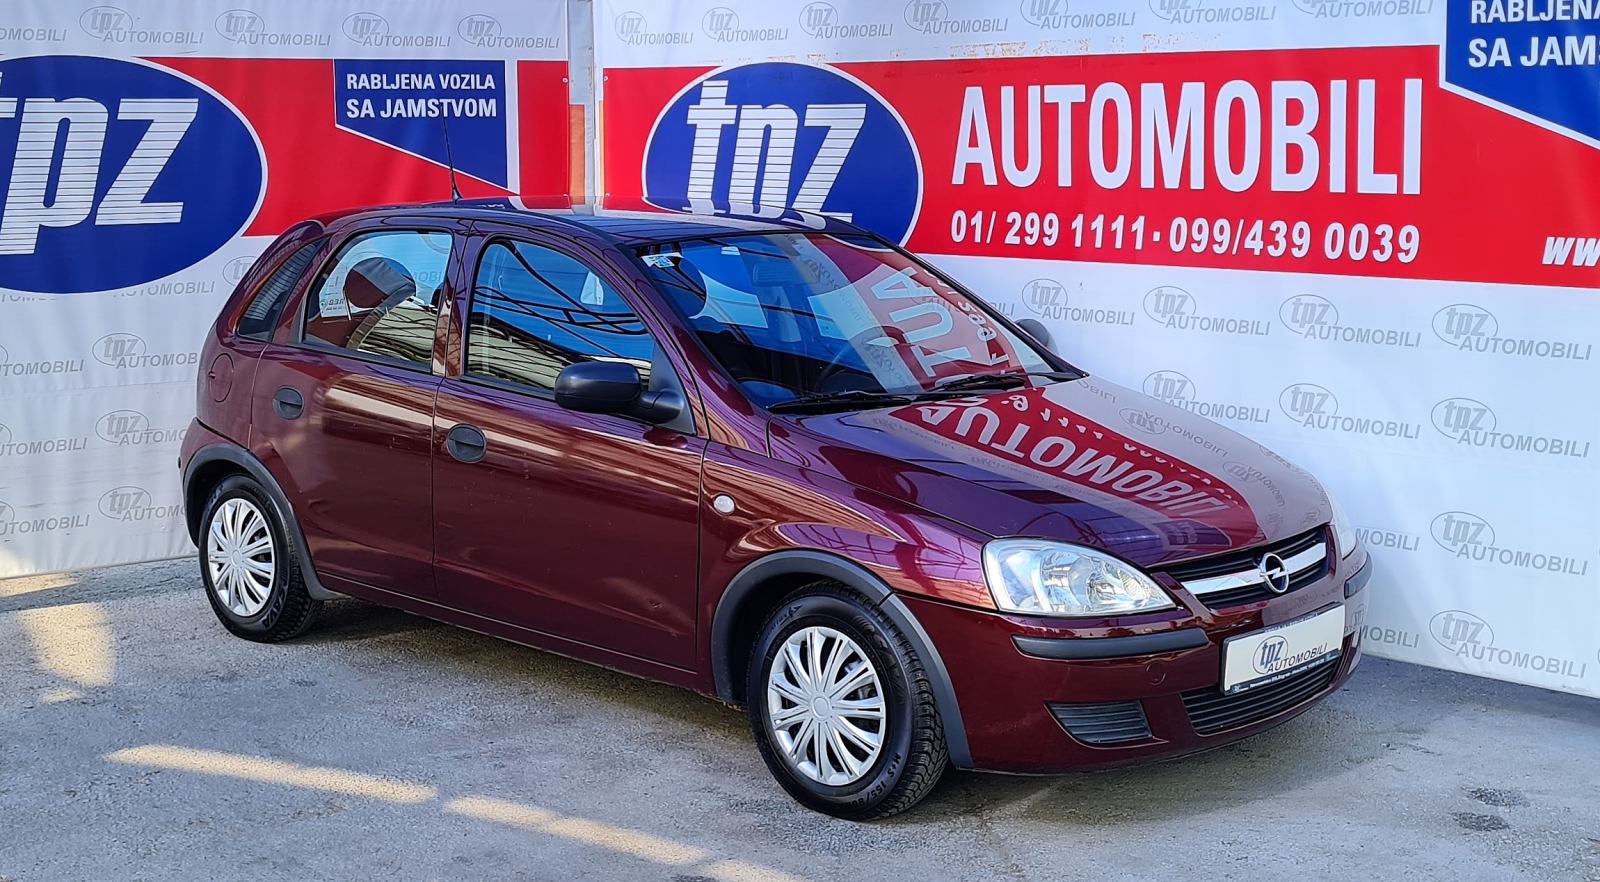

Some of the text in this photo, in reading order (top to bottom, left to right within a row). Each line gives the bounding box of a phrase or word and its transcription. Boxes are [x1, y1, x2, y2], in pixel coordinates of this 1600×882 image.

[1170, 6, 1276, 24] AUTOMOBILI
[1315, 0, 1434, 19] AUTOMOBILI
[1471, 0, 1600, 23] RABLJEN
[923, 17, 1009, 35] AUTOMOBILI
[1041, 12, 1136, 29] AUTOMOBILI
[103, 30, 204, 44] AUTOMOBILI
[237, 33, 331, 46] AUTOMOBILI
[363, 35, 451, 47] AUTOMOBILI
[627, 32, 694, 46] AUTOMOBILI
[717, 28, 789, 42] AUTOMOBILI
[815, 24, 894, 39] AUTOMOBILI
[476, 37, 560, 49] AUTOMOBILI
[1468, 35, 1600, 68] SA JAM
[347, 74, 496, 90] RABLJENA VOZILA
[346, 98, 497, 118] SA JAMSTVOM
[952, 78, 1423, 195] AUTOMOBILI
[0, 72, 199, 255] pz
[951, 210, 997, 244] 01/
[1004, 212, 1060, 246] 299
[1324, 223, 1421, 264] 0039
[1040, 305, 1135, 326] AUTOMOBILI
[1166, 315, 1271, 336] AUTOMOBILI
[1303, 324, 1422, 348] AUTOMOBILI
[1459, 335, 1593, 361] AUTOMOBILI
[116, 352, 198, 369] AUTOMOB
[1303, 413, 1422, 439] AUTOMOBILI
[119, 429, 185, 446] AUTOMO
[1457, 430, 1591, 458] AUTOMOBILI
[121, 505, 185, 522] AUTOMO
[1455, 543, 1588, 577] AUTOMOBILI
[1260, 641, 1285, 669] tpz
[1266, 642, 1328, 673] AUTOMOBILI
[1455, 642, 1587, 679] AUTOMOBILI
